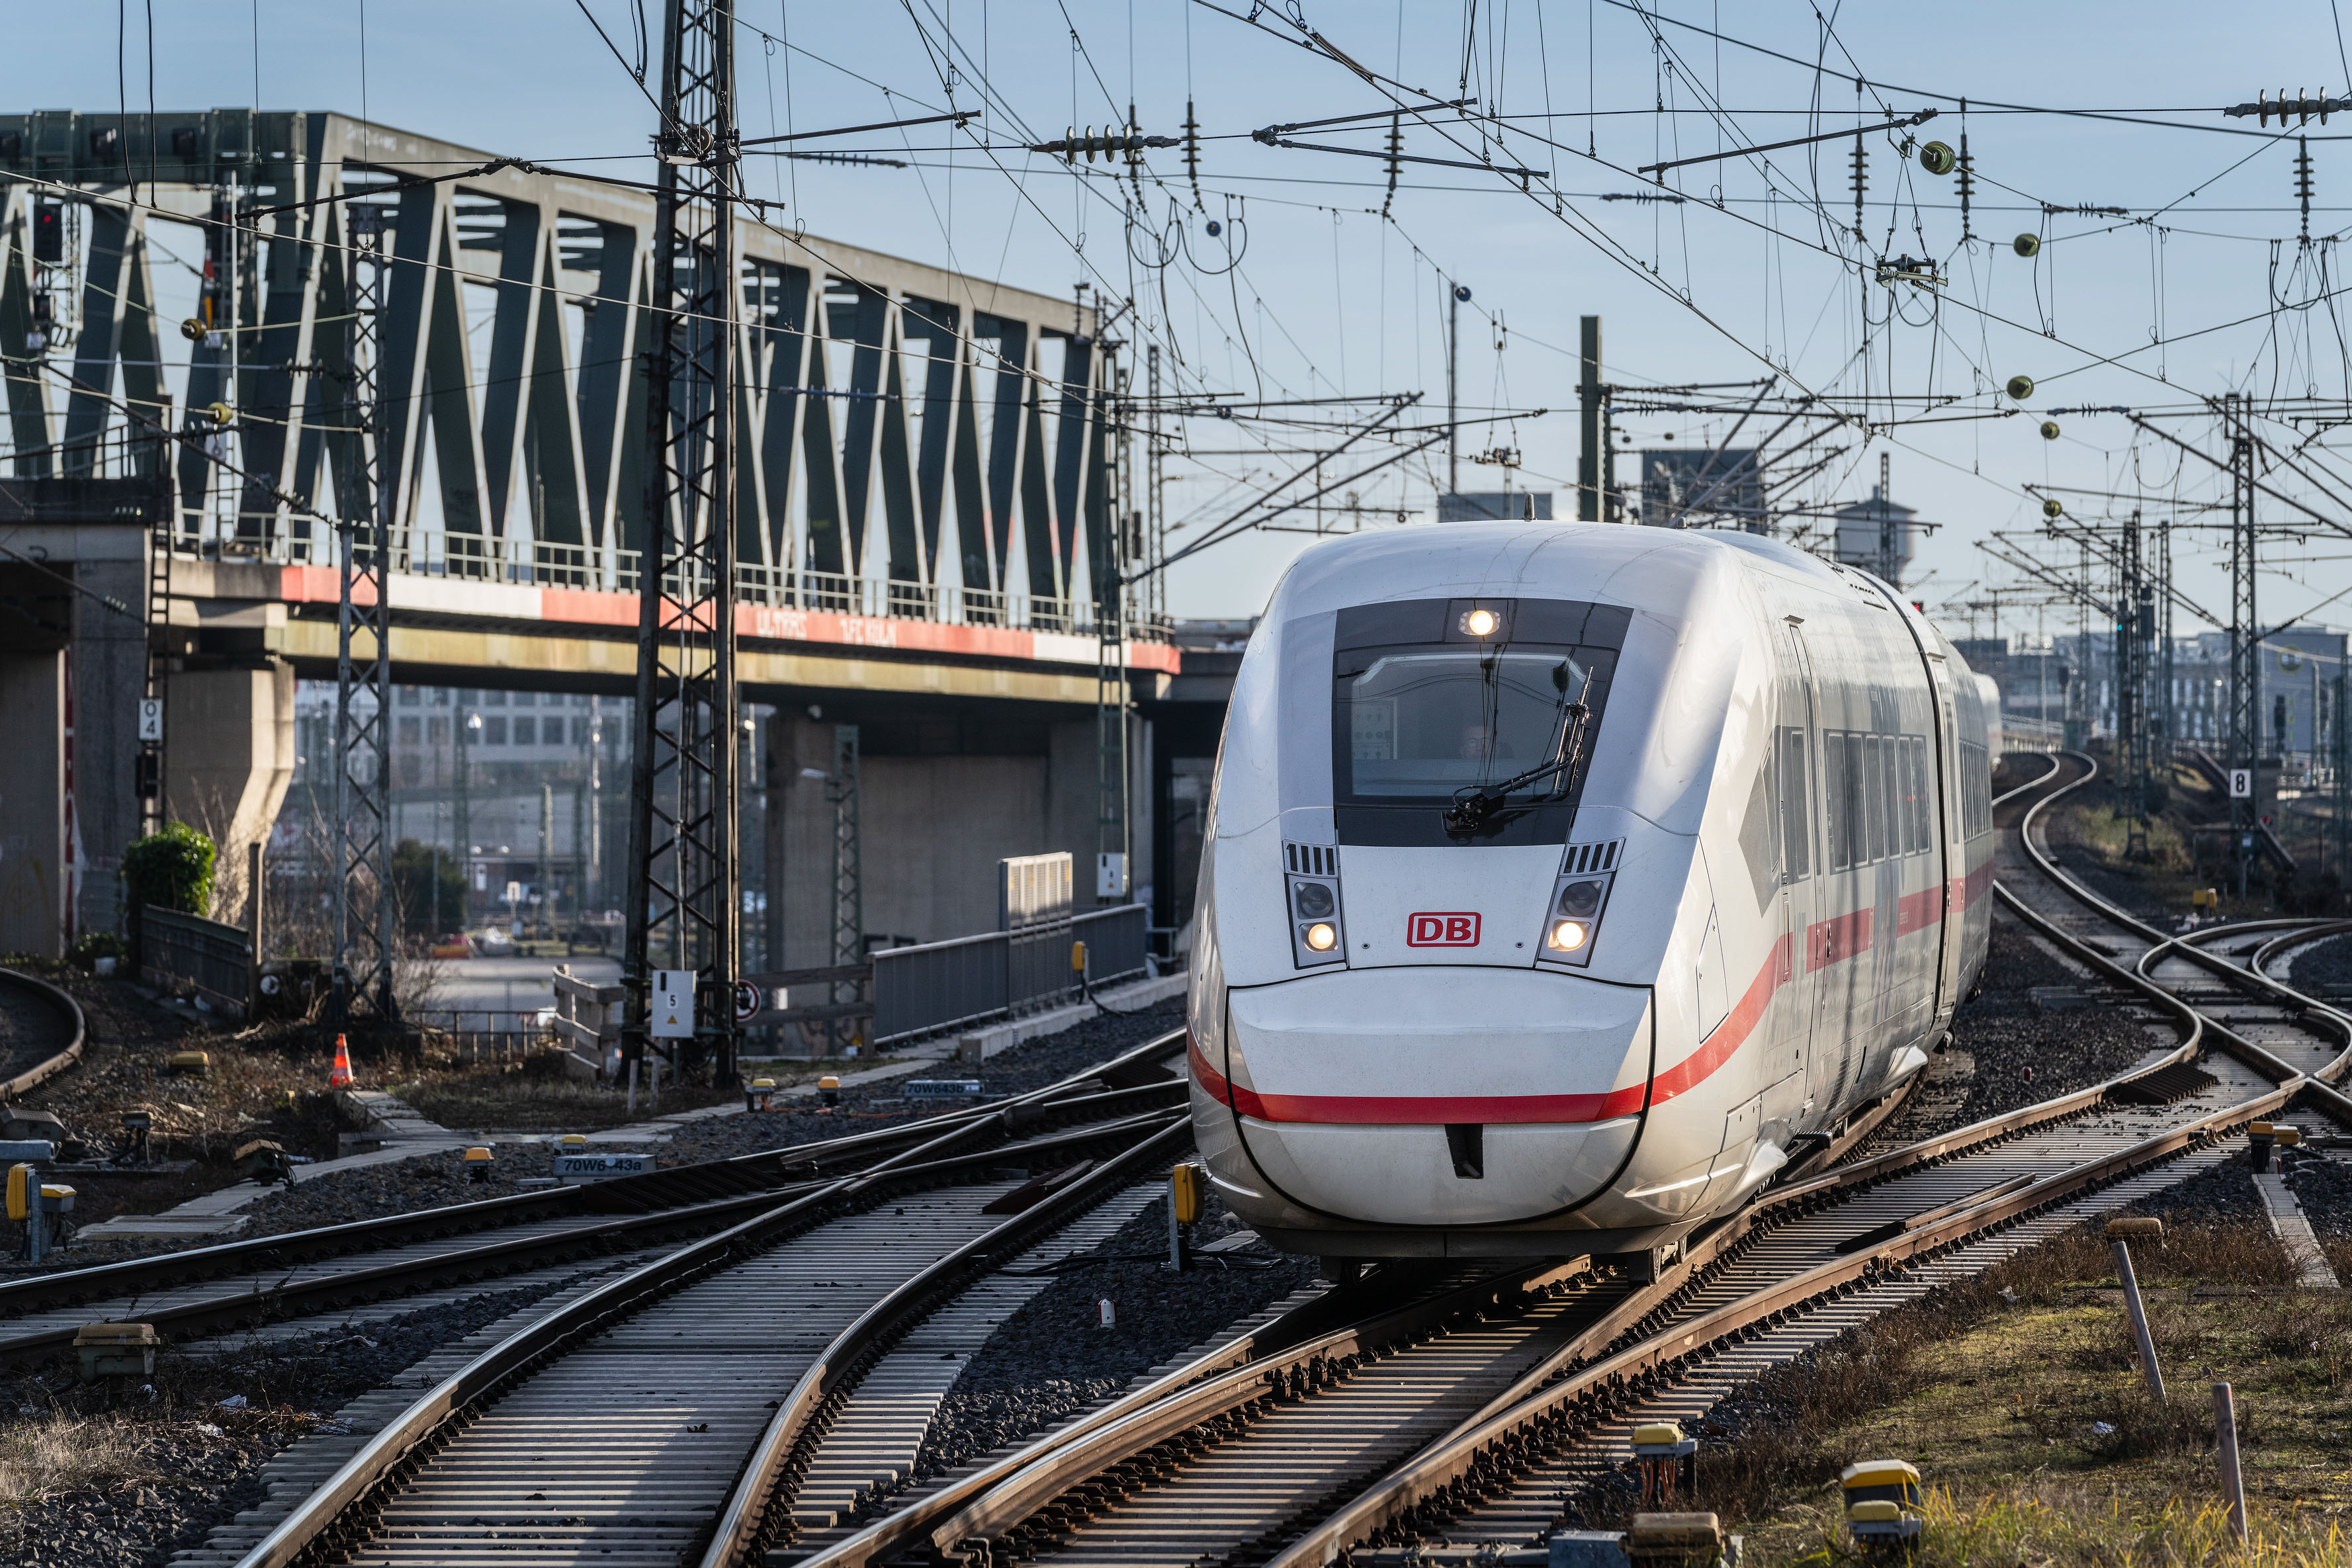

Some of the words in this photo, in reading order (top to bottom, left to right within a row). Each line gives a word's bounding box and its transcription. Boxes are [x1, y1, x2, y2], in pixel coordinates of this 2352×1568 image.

[2236, 773, 2245, 793] 8
[1416, 917, 1473, 942] DB
[670, 994, 676, 1006] 5
[907, 1084, 965, 1094] 70W643b
